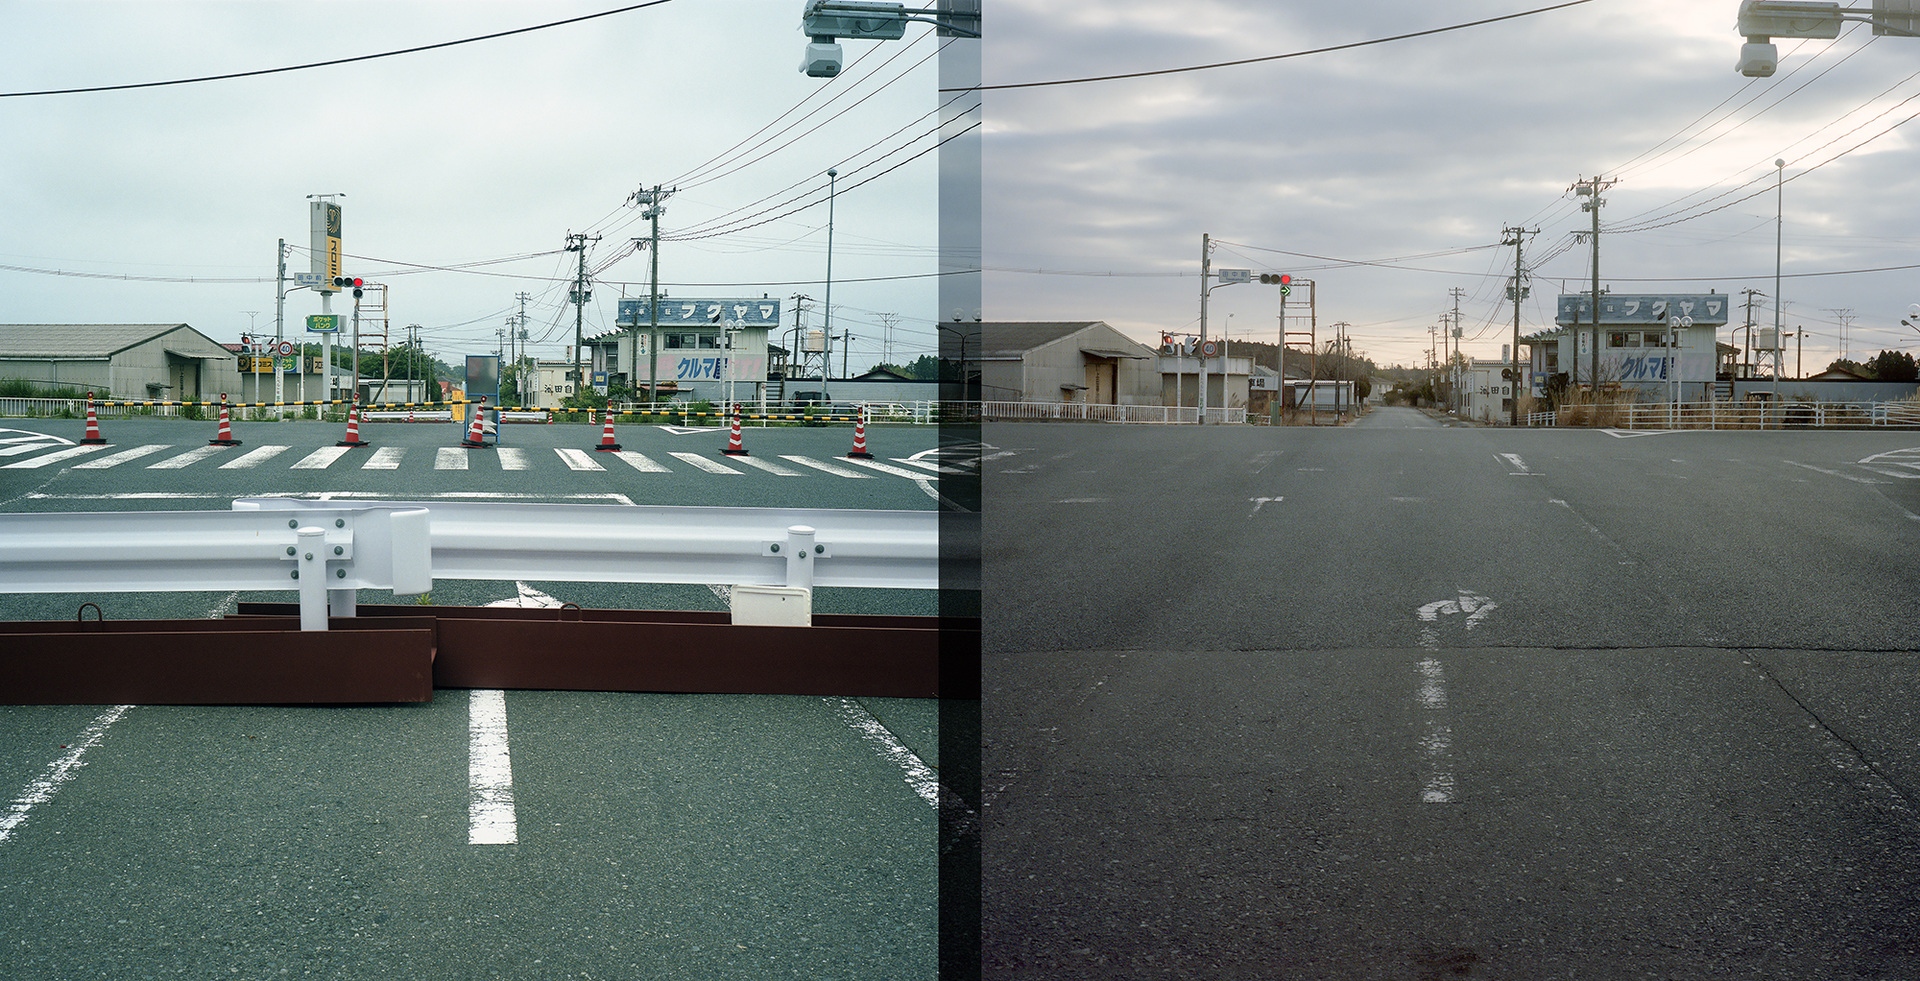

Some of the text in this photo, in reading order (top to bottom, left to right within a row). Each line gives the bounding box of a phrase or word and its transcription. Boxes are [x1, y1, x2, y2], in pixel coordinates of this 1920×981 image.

[681, 304, 774, 320] フクヤマ
[1624, 300, 1722, 316] フクヤマ
[280, 345, 290, 353] 40
[1204, 344, 1214, 353] 40
